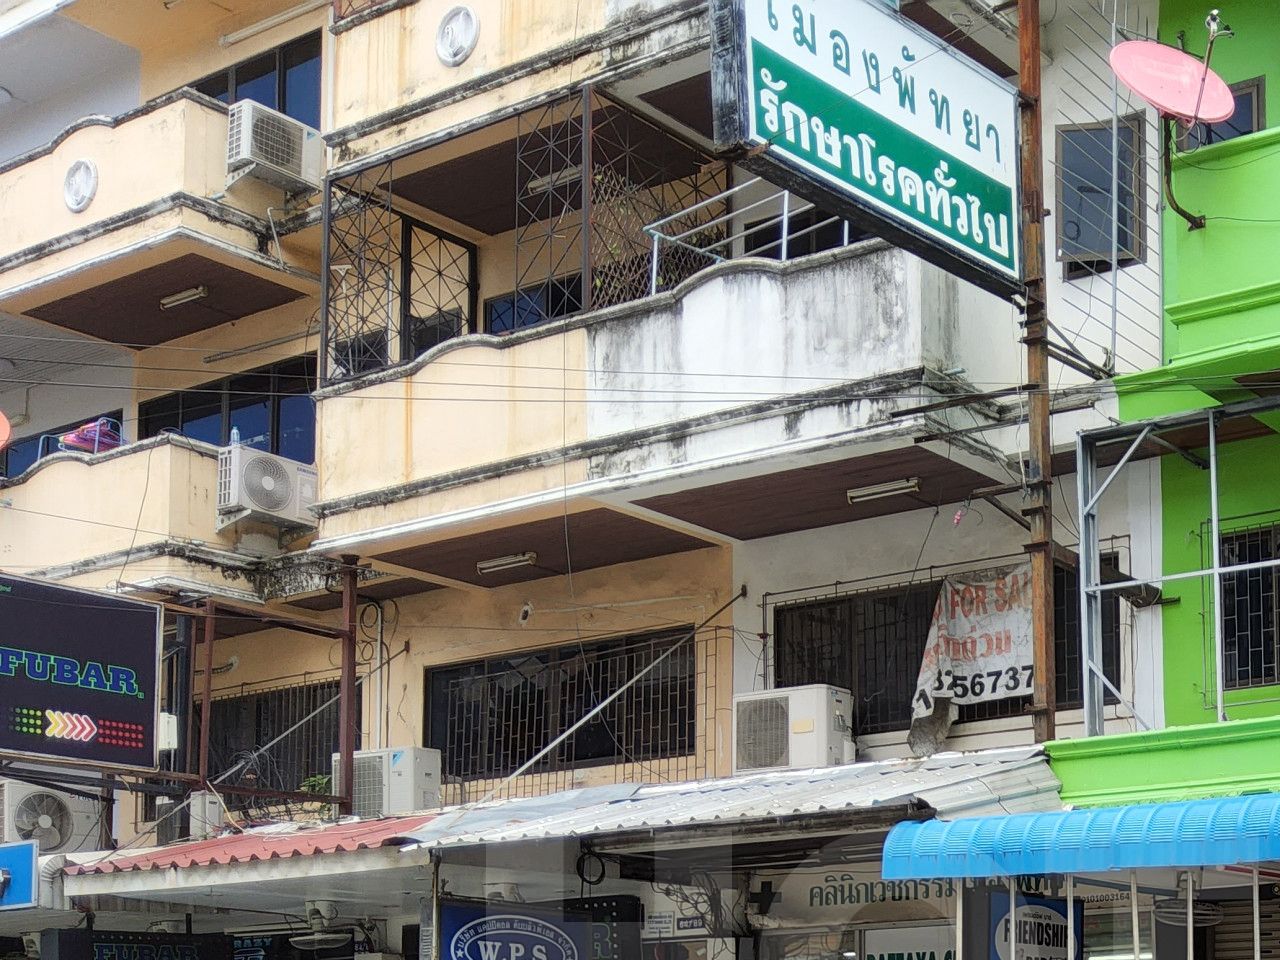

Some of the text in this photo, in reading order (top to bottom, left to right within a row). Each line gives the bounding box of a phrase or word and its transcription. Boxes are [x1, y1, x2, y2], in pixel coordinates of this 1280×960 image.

[760, 67, 1009, 257] รักษาโรคทั่วไป
[950, 584, 988, 619] FOR
